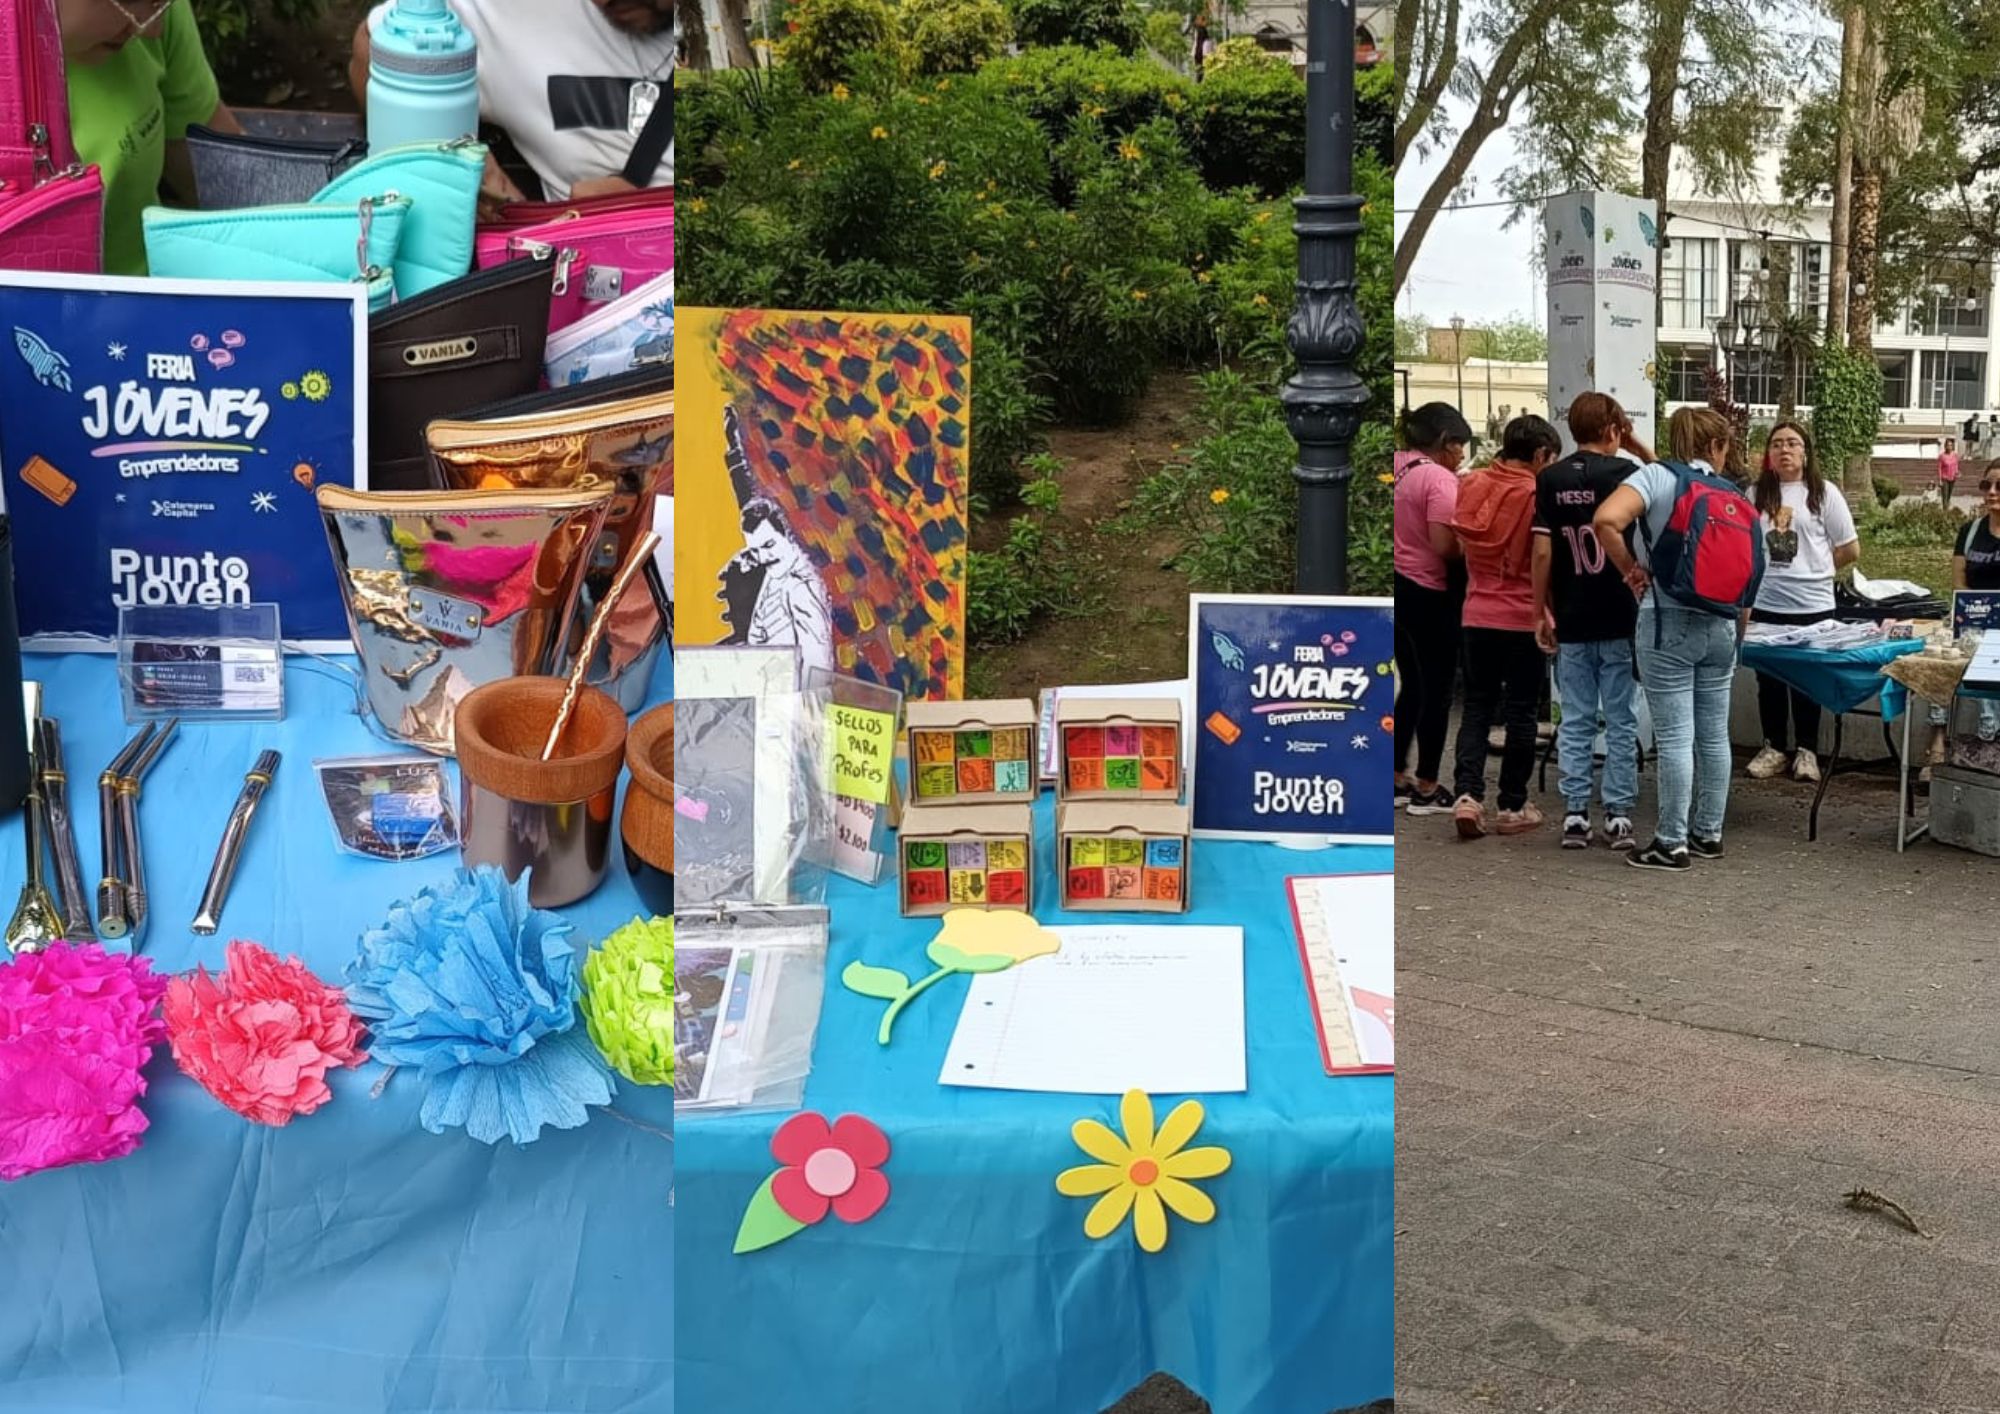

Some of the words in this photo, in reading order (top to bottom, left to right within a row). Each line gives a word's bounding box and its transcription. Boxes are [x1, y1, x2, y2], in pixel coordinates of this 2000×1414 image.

[418, 343, 465, 360] VANIA
[147, 353, 196, 382] FERIA
[82, 380, 270, 440] JÓVENES
[119, 453, 240, 478] Emprendedores
[1556, 490, 1595, 505] MESSI
[162, 510, 198, 518] Capital
[1561, 525, 1605, 575] 10
[110, 548, 249, 585] Punto
[112, 574, 251, 611] Joven
[425, 614, 462, 633] VANIA
[1294, 645, 1324, 662] FERIA
[1250, 663, 1370, 700] JÓVENES
[834, 710, 883, 735] SELLOS
[1267, 710, 1346, 726] Emprendedores
[848, 735, 878, 757] PARA
[1253, 770, 1344, 797] Punto
[1253, 788, 1345, 815] Joven
